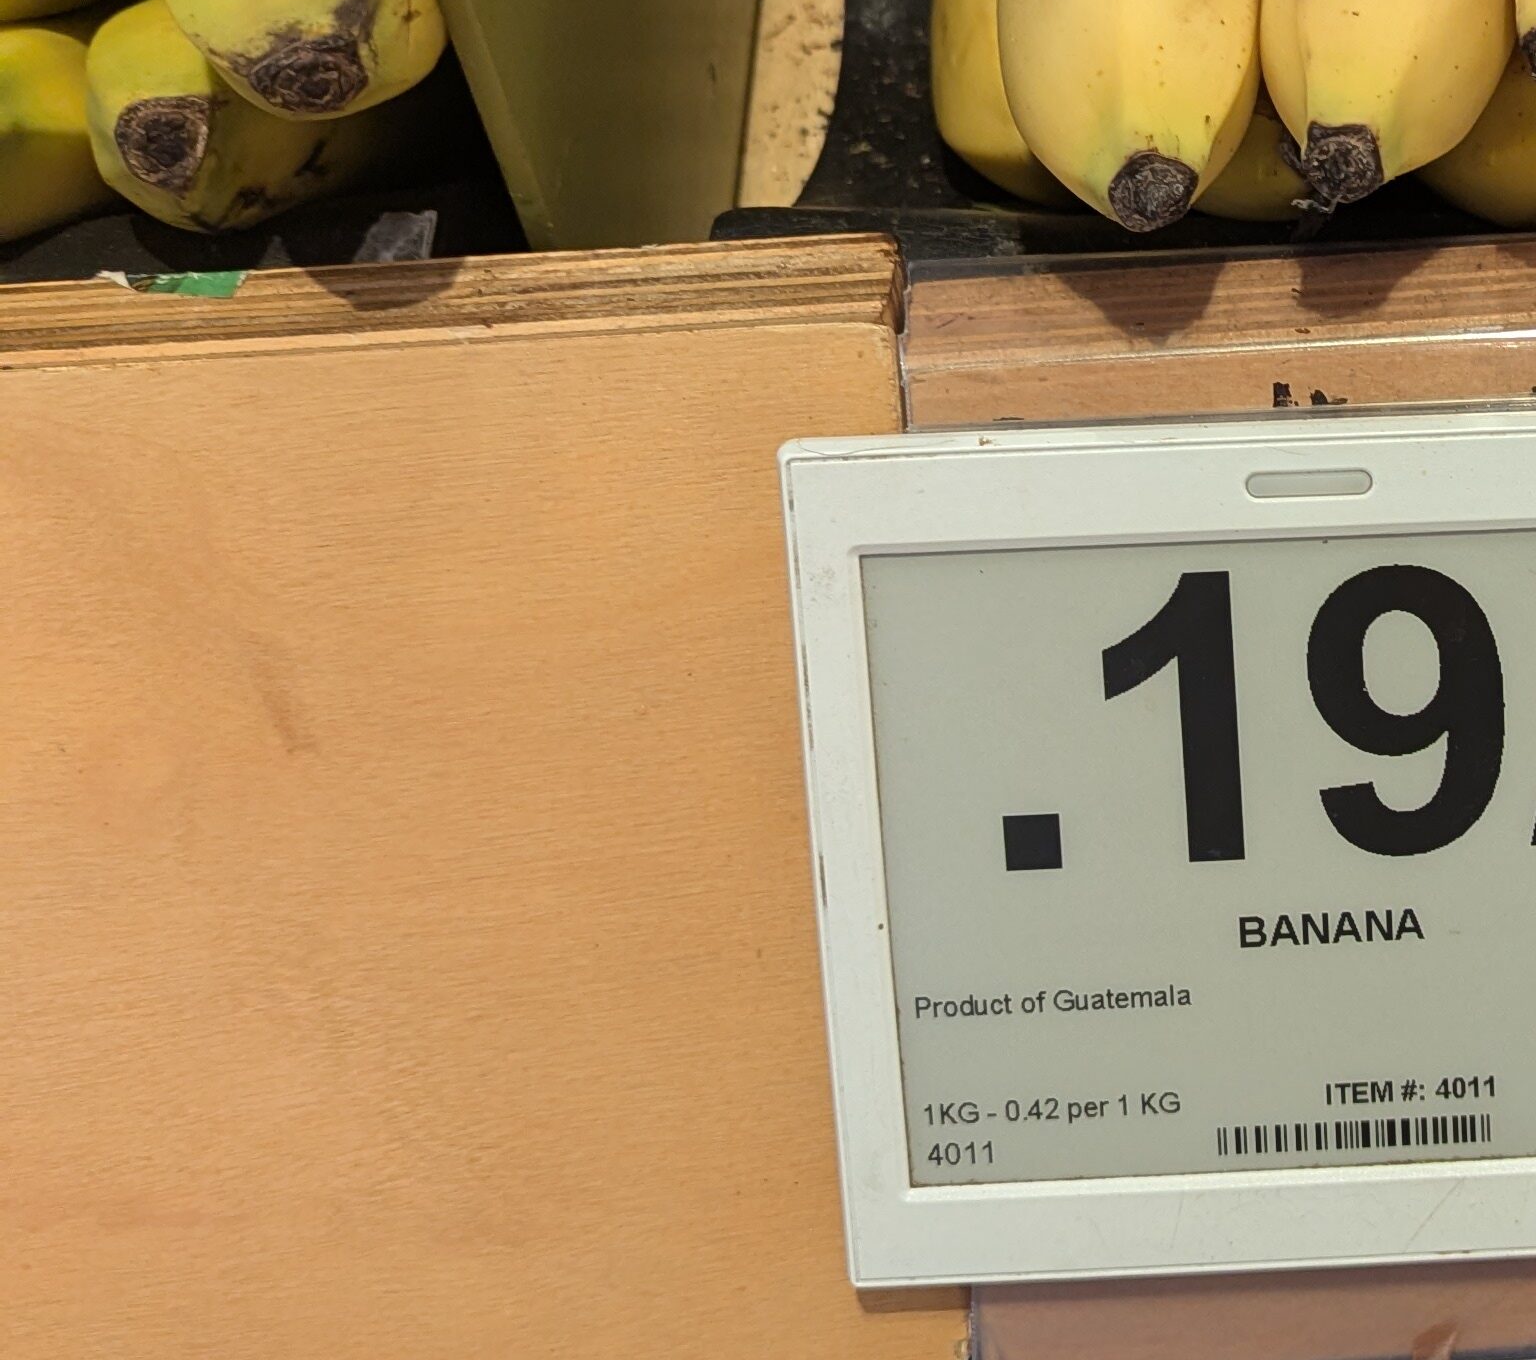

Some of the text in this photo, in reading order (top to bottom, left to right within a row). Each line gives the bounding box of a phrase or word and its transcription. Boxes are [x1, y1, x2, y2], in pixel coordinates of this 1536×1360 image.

[1002, 564, 1506, 872] .19
[1238, 908, 1425, 950] BANANA
[914, 984, 1193, 1019] Product of Guatemala
[923, 1101, 980, 1126] 1KG
[1004, 1097, 1060, 1122] 0.42
[1066, 1099, 1109, 1124] per
[1117, 1094, 1129, 1117] 1
[1141, 1090, 1182, 1115] KG
[1325, 1075, 1497, 1106] ITEM #: 4011
[927, 1139, 995, 1166] 4011
